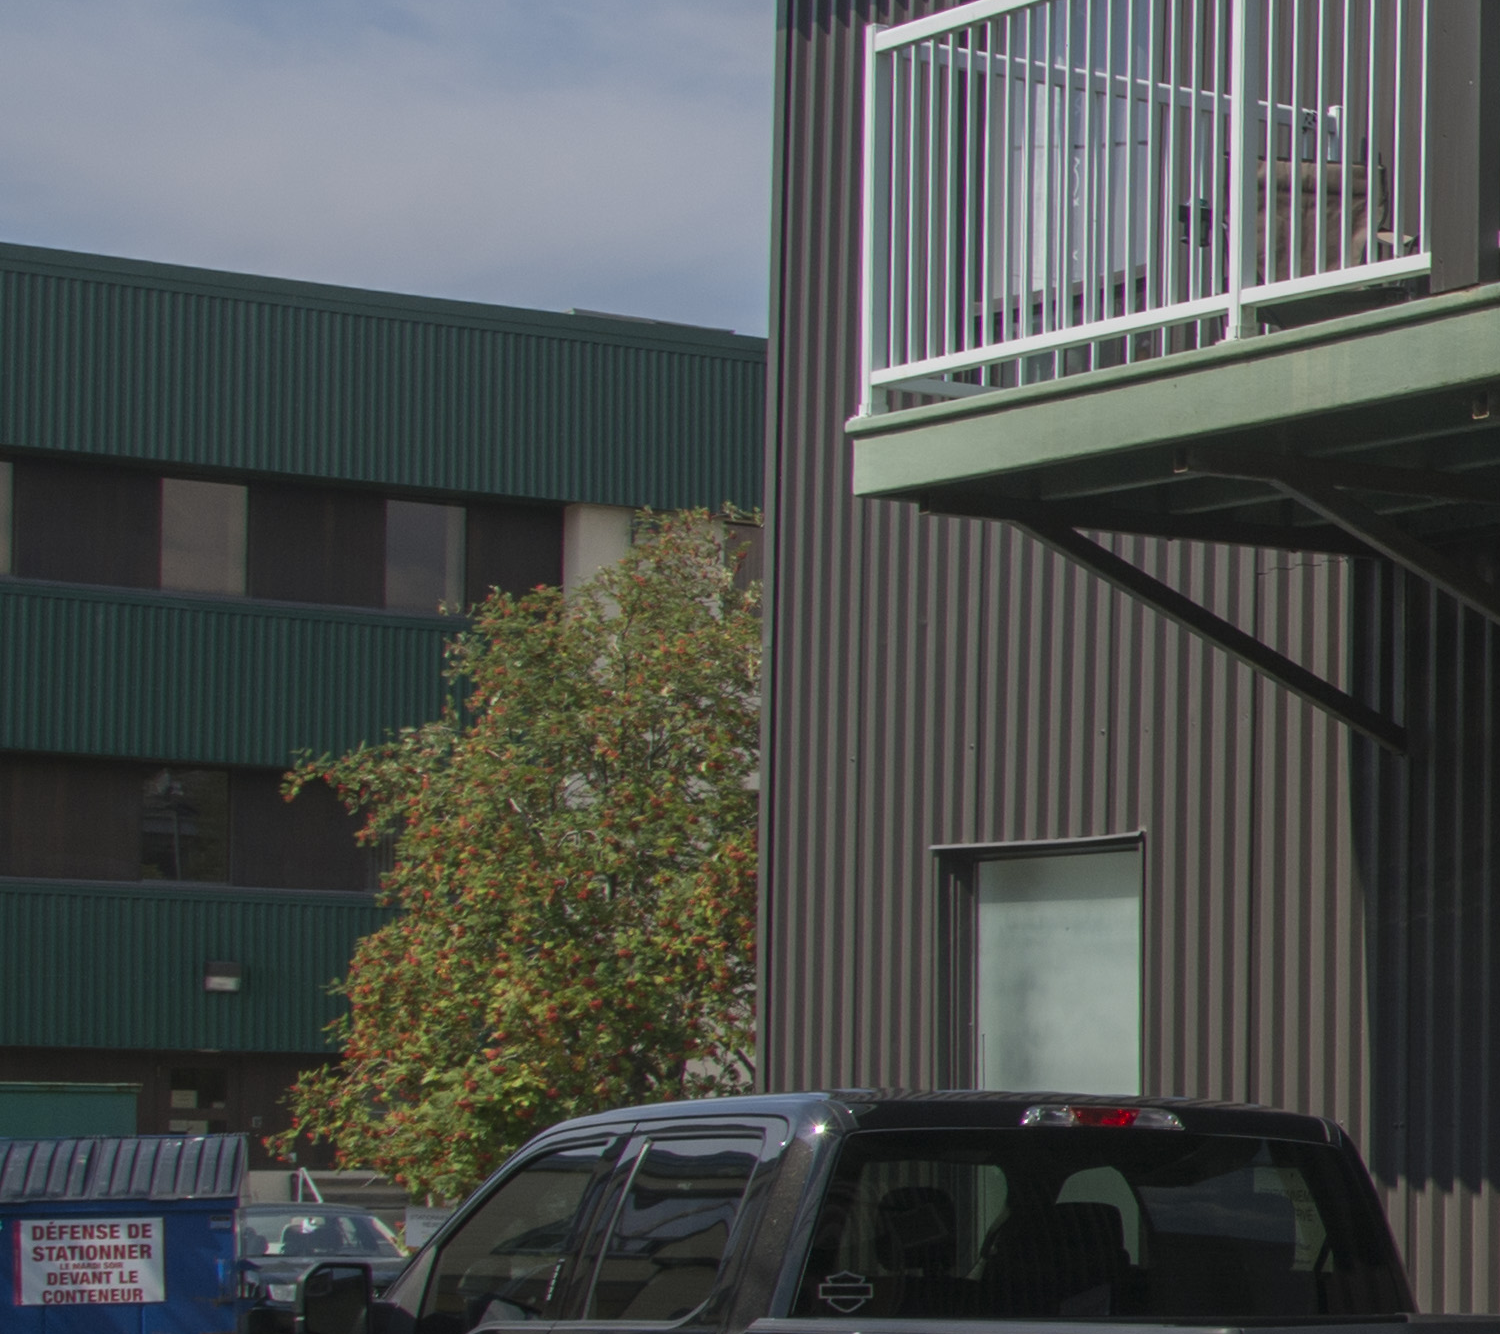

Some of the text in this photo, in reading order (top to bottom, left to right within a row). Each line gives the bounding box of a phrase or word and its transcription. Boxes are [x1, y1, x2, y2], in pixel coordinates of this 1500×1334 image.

[32, 1222, 153, 1241] DÉFENSE DE
[32, 1244, 152, 1262] STATIONNER
[72, 1262, 100, 1270] MARDI
[103, 1261, 124, 1269] SOIR
[47, 1271, 138, 1286] DEVANT LE
[42, 1288, 143, 1304] CONTENEUR
